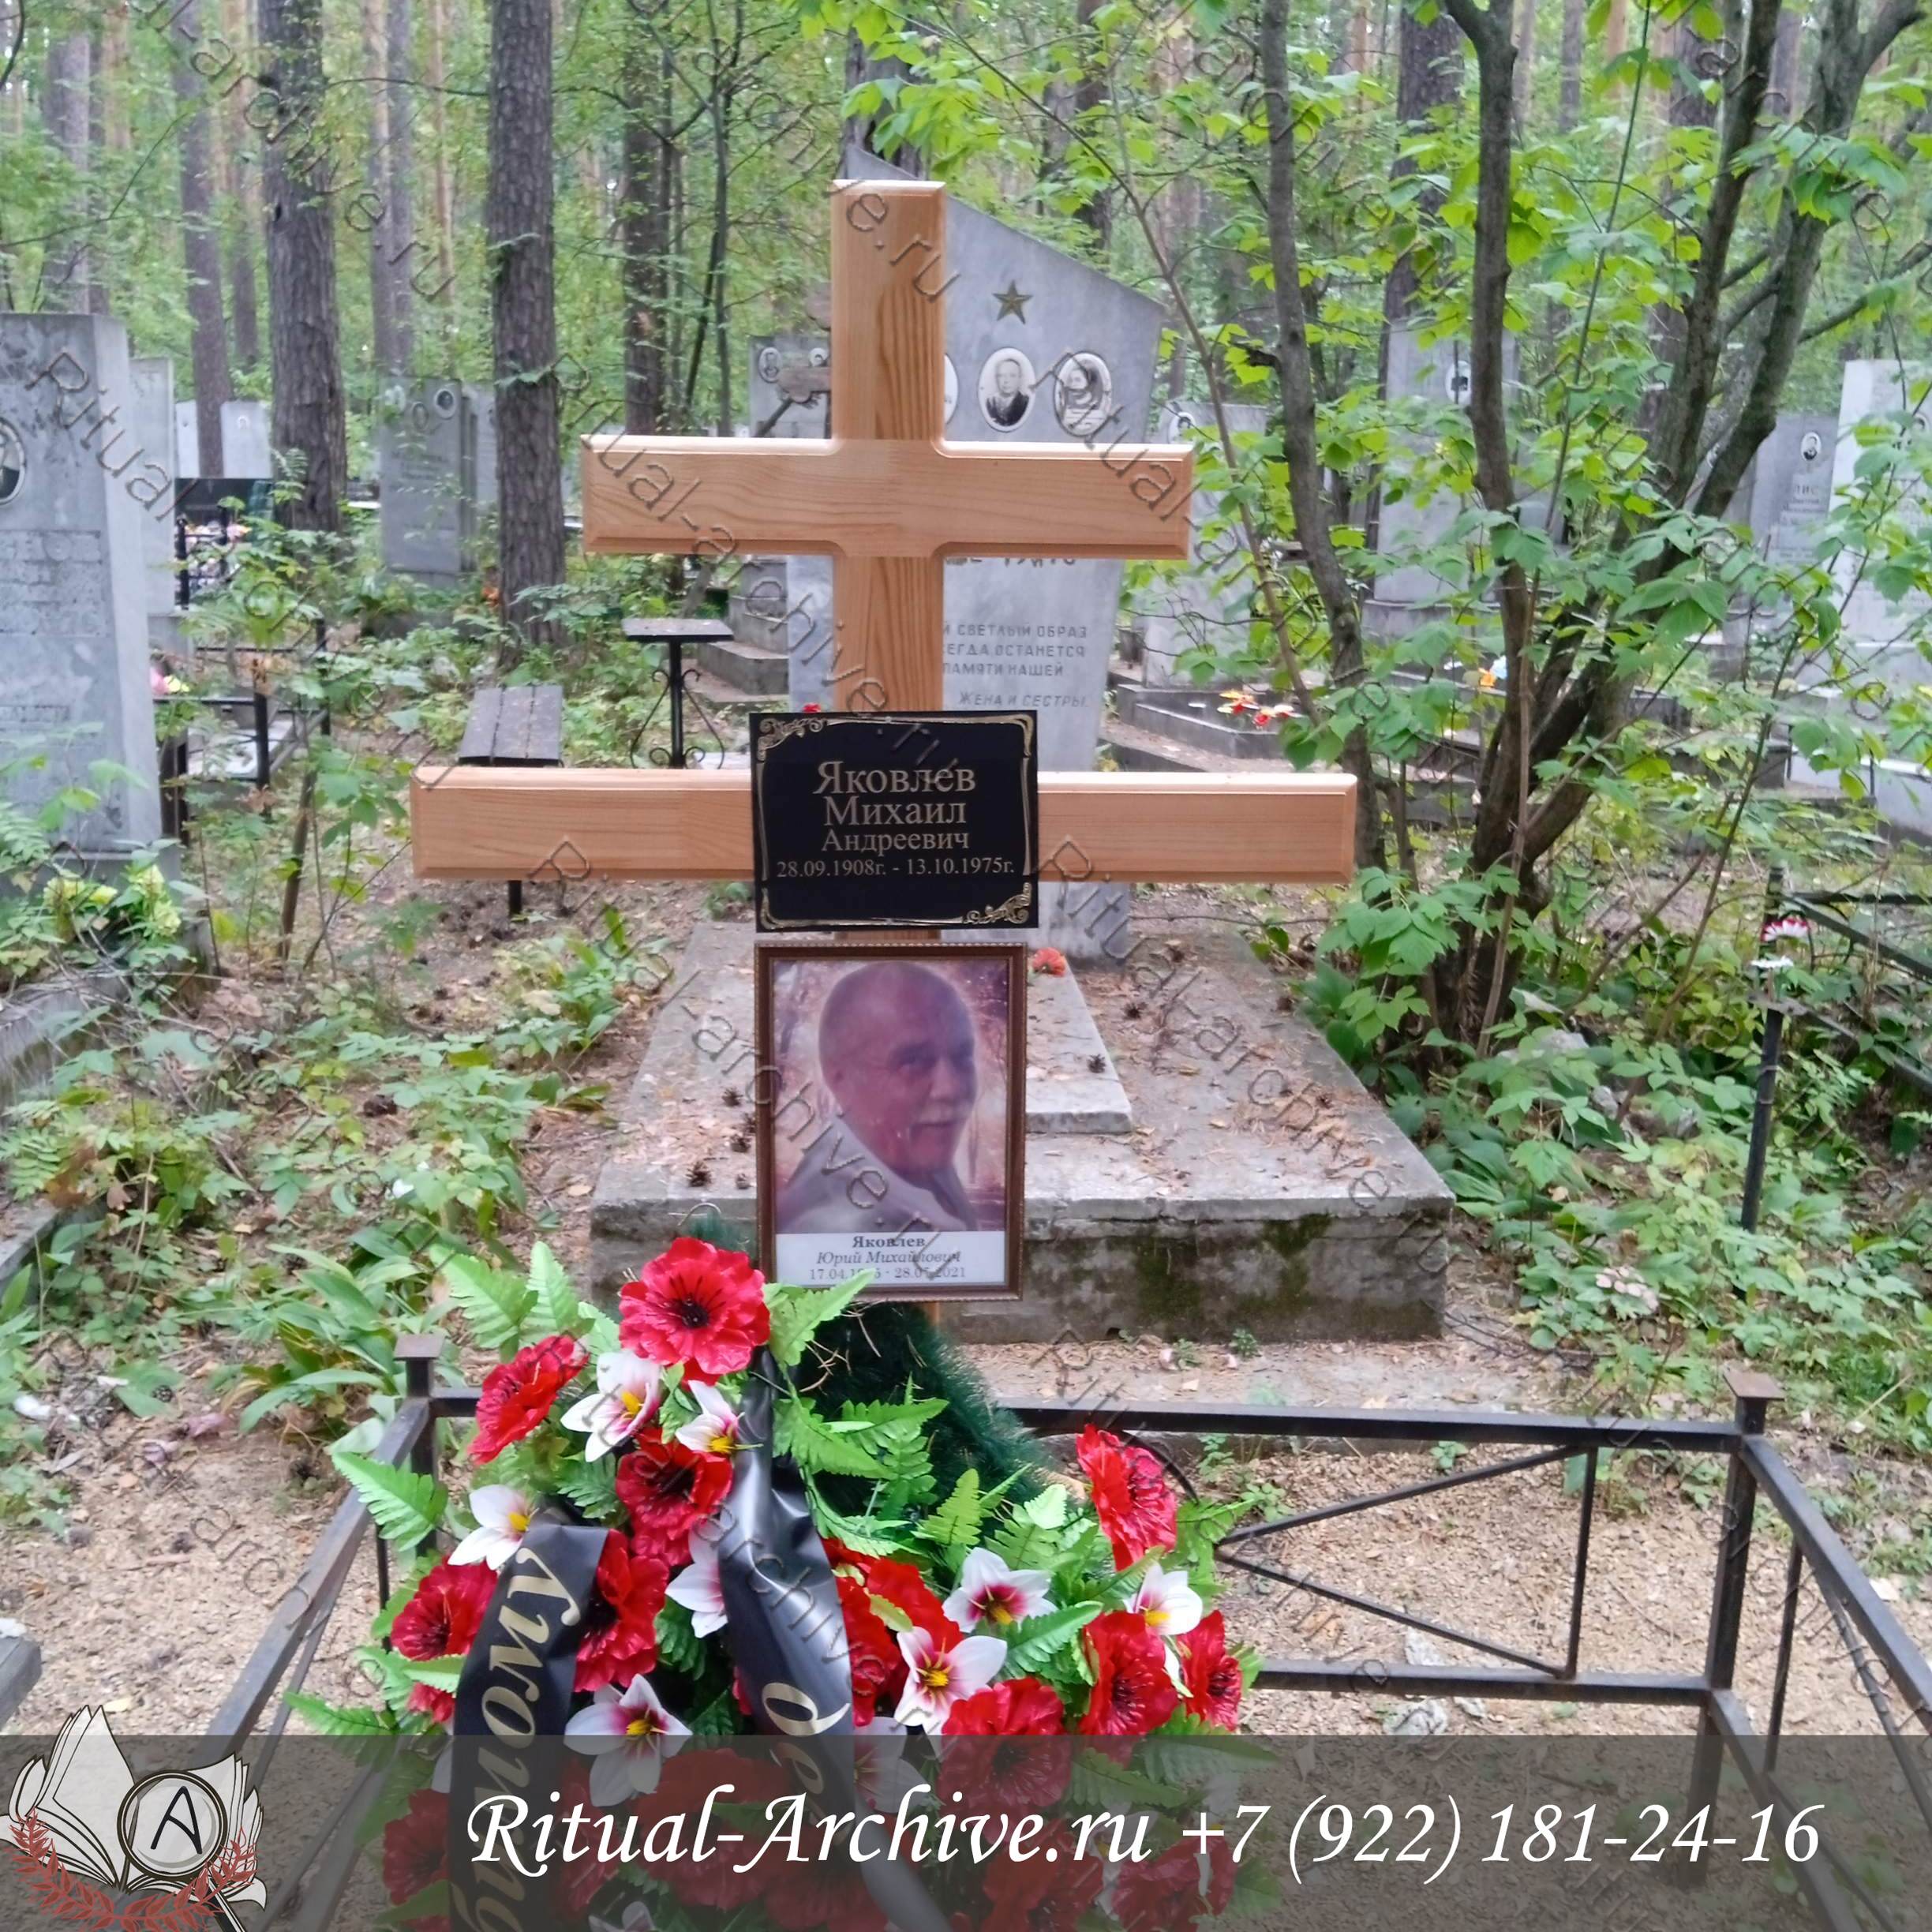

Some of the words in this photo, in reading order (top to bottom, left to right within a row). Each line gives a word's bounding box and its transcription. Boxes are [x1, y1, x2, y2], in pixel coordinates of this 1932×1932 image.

[1037, 625, 1088, 638] ОБРАЗ
[943, 643, 990, 657] ЕГДА
[994, 644, 1086, 657] ОСТАНЕТСЯ
[1008, 661, 1064, 676] НАШЕЙ
[959, 691, 1002, 707] ЖЕНА
[1008, 695, 1017, 706] И
[813, 761, 976, 794] Яковлев
[823, 796, 967, 826] Михаил
[822, 829, 970, 856] Андреевич
[777, 859, 887, 878] 28.09.1908г.
[906, 857, 1015, 875] 13.10.1975г.
[852, 1235, 926, 1249] Яковлев
[816, 1251, 862, 1267] Юрий
